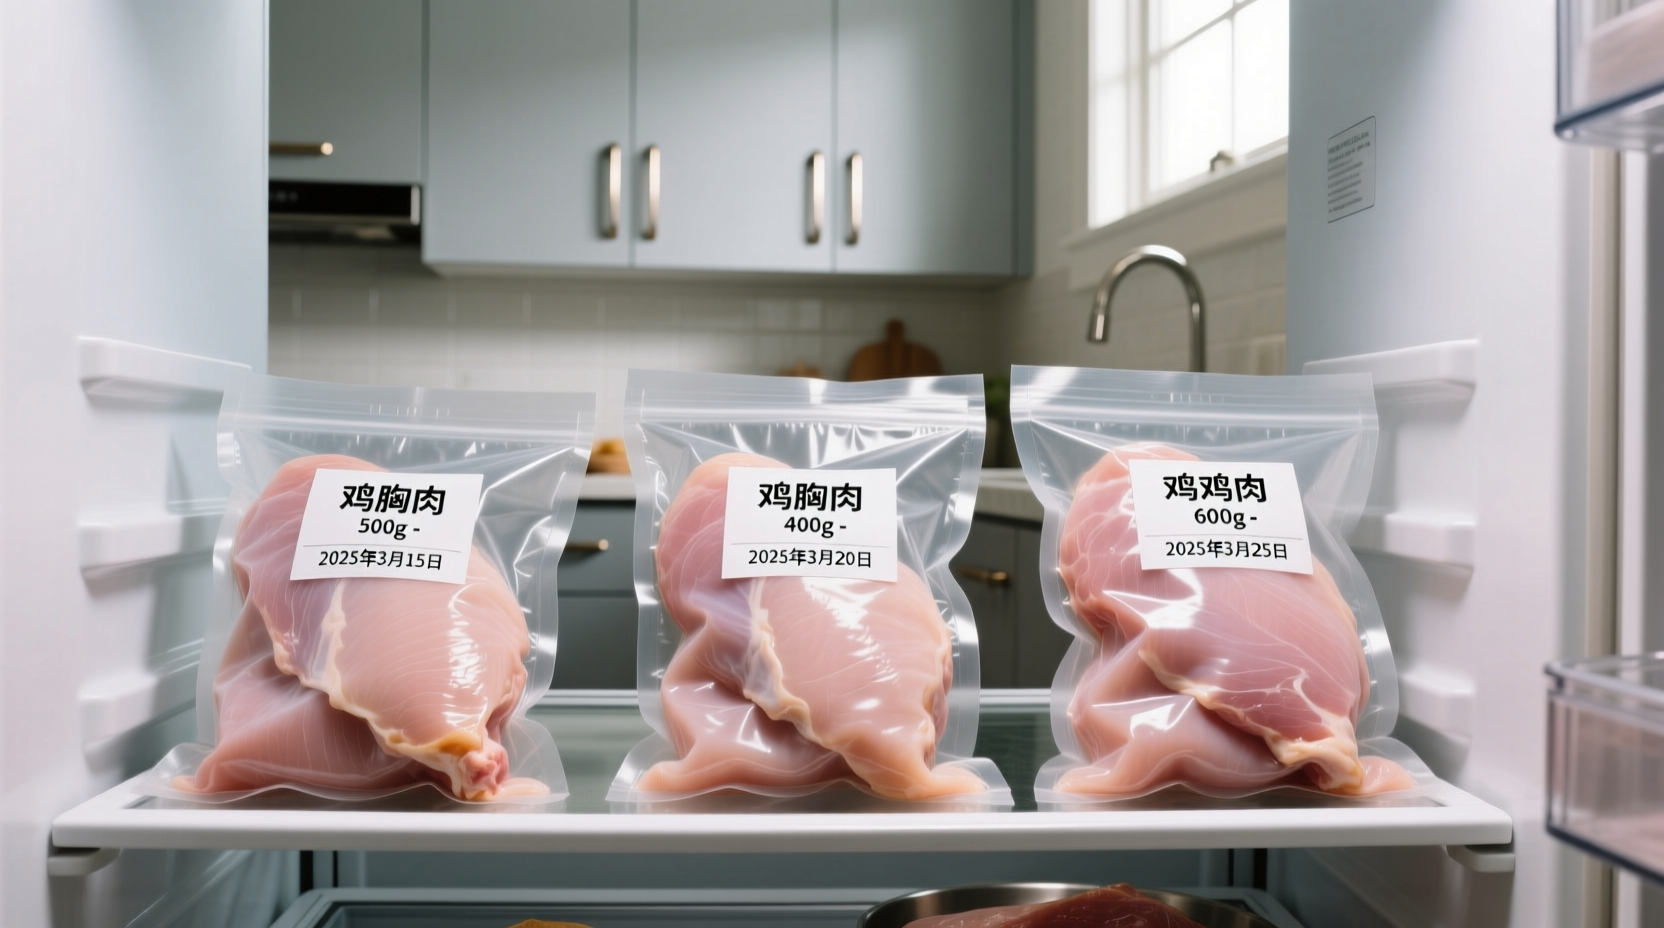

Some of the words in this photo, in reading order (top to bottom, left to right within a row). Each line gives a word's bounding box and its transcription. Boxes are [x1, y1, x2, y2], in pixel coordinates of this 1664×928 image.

[758, 481, 862, 512] 鸡胸肉
[1163, 472, 1267, 503] 鸡鸡肉
[340, 483, 446, 515] 鸡胸肉
[358, 518, 408, 541] 500g
[784, 516, 834, 538] 400g
[1194, 508, 1246, 530] 600g
[318, 548, 442, 570] 2025年3月15日
[748, 547, 871, 568] 2025年3月20日
[1165, 539, 1288, 559] 2025年3月25日
